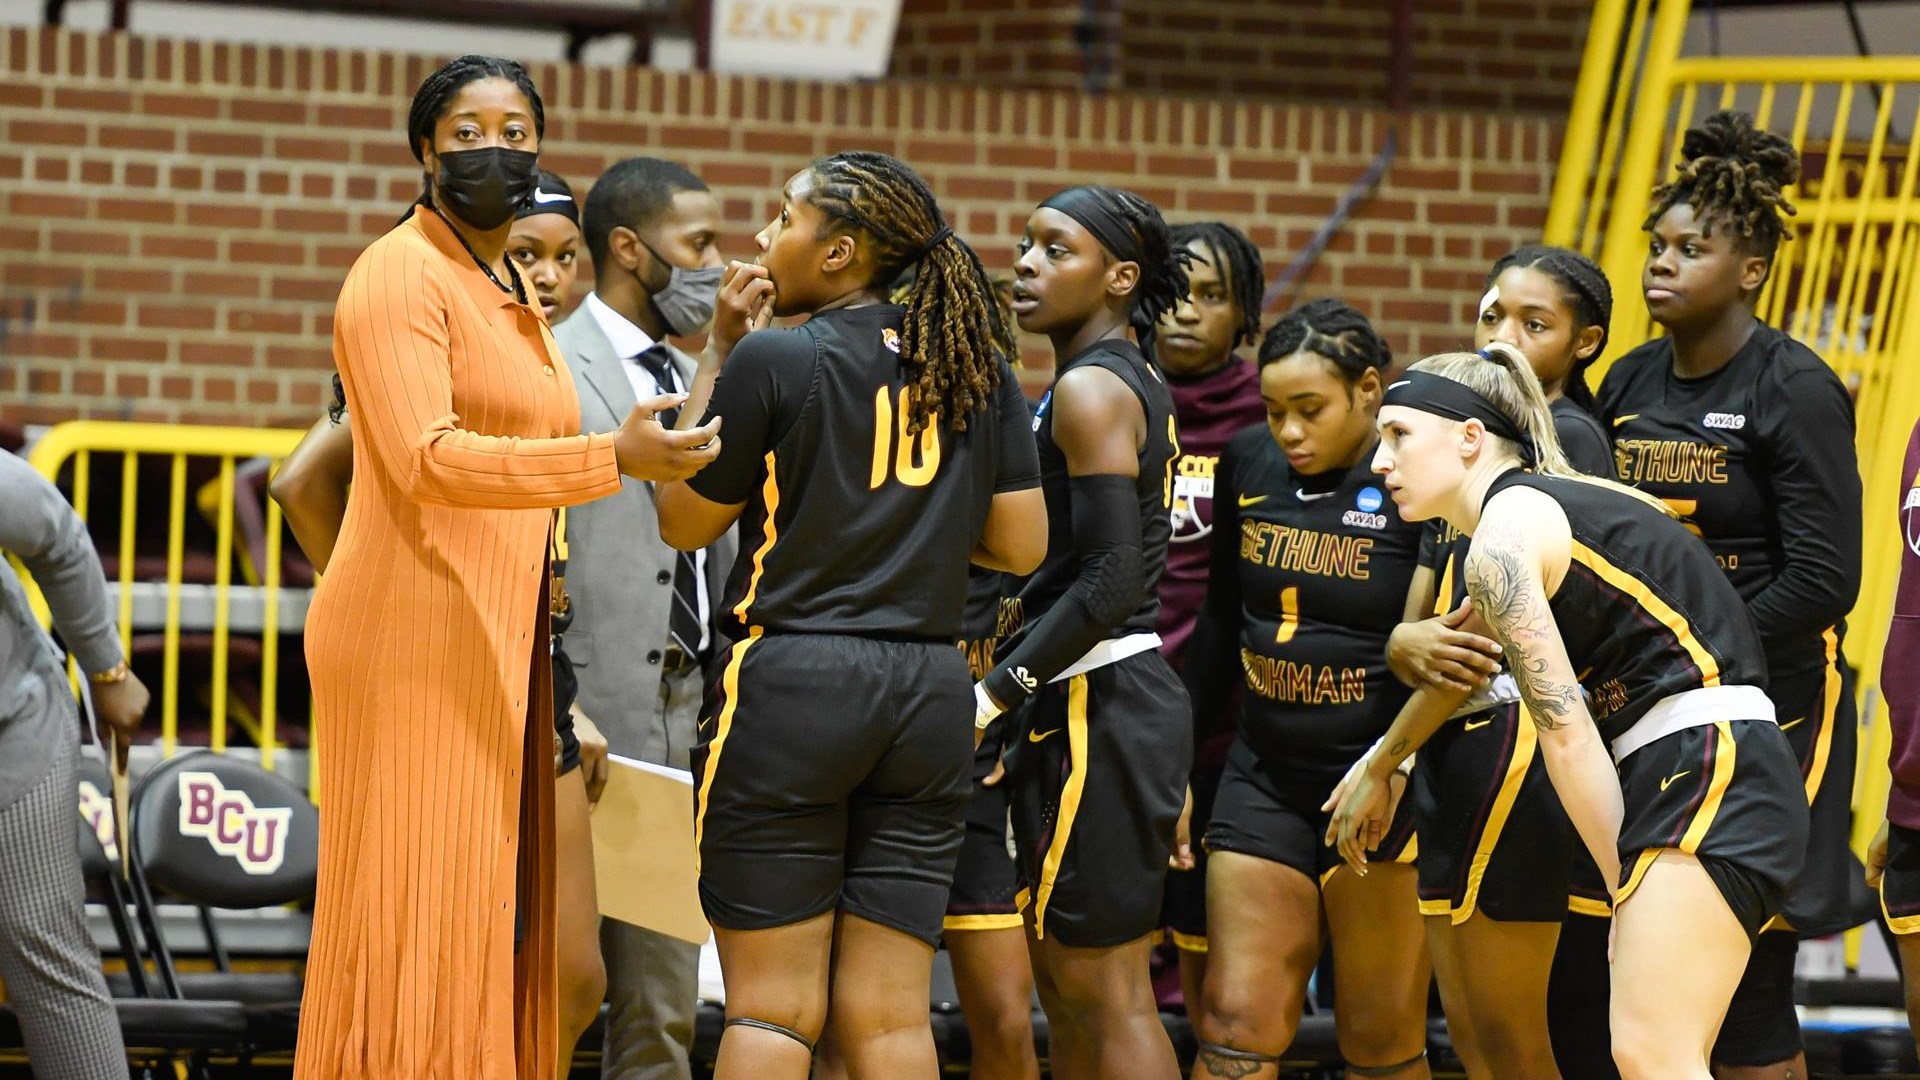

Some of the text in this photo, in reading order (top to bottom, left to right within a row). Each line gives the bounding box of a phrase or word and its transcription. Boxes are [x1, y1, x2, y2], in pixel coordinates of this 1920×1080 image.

[726, 0, 842, 42] EAST
[869, 384, 941, 490] 10
[1703, 412, 1746, 430] SWAC
[1342, 510, 1387, 530] SWAC
[1275, 586, 1299, 644] 1
[186, 780, 280, 866] BCU
